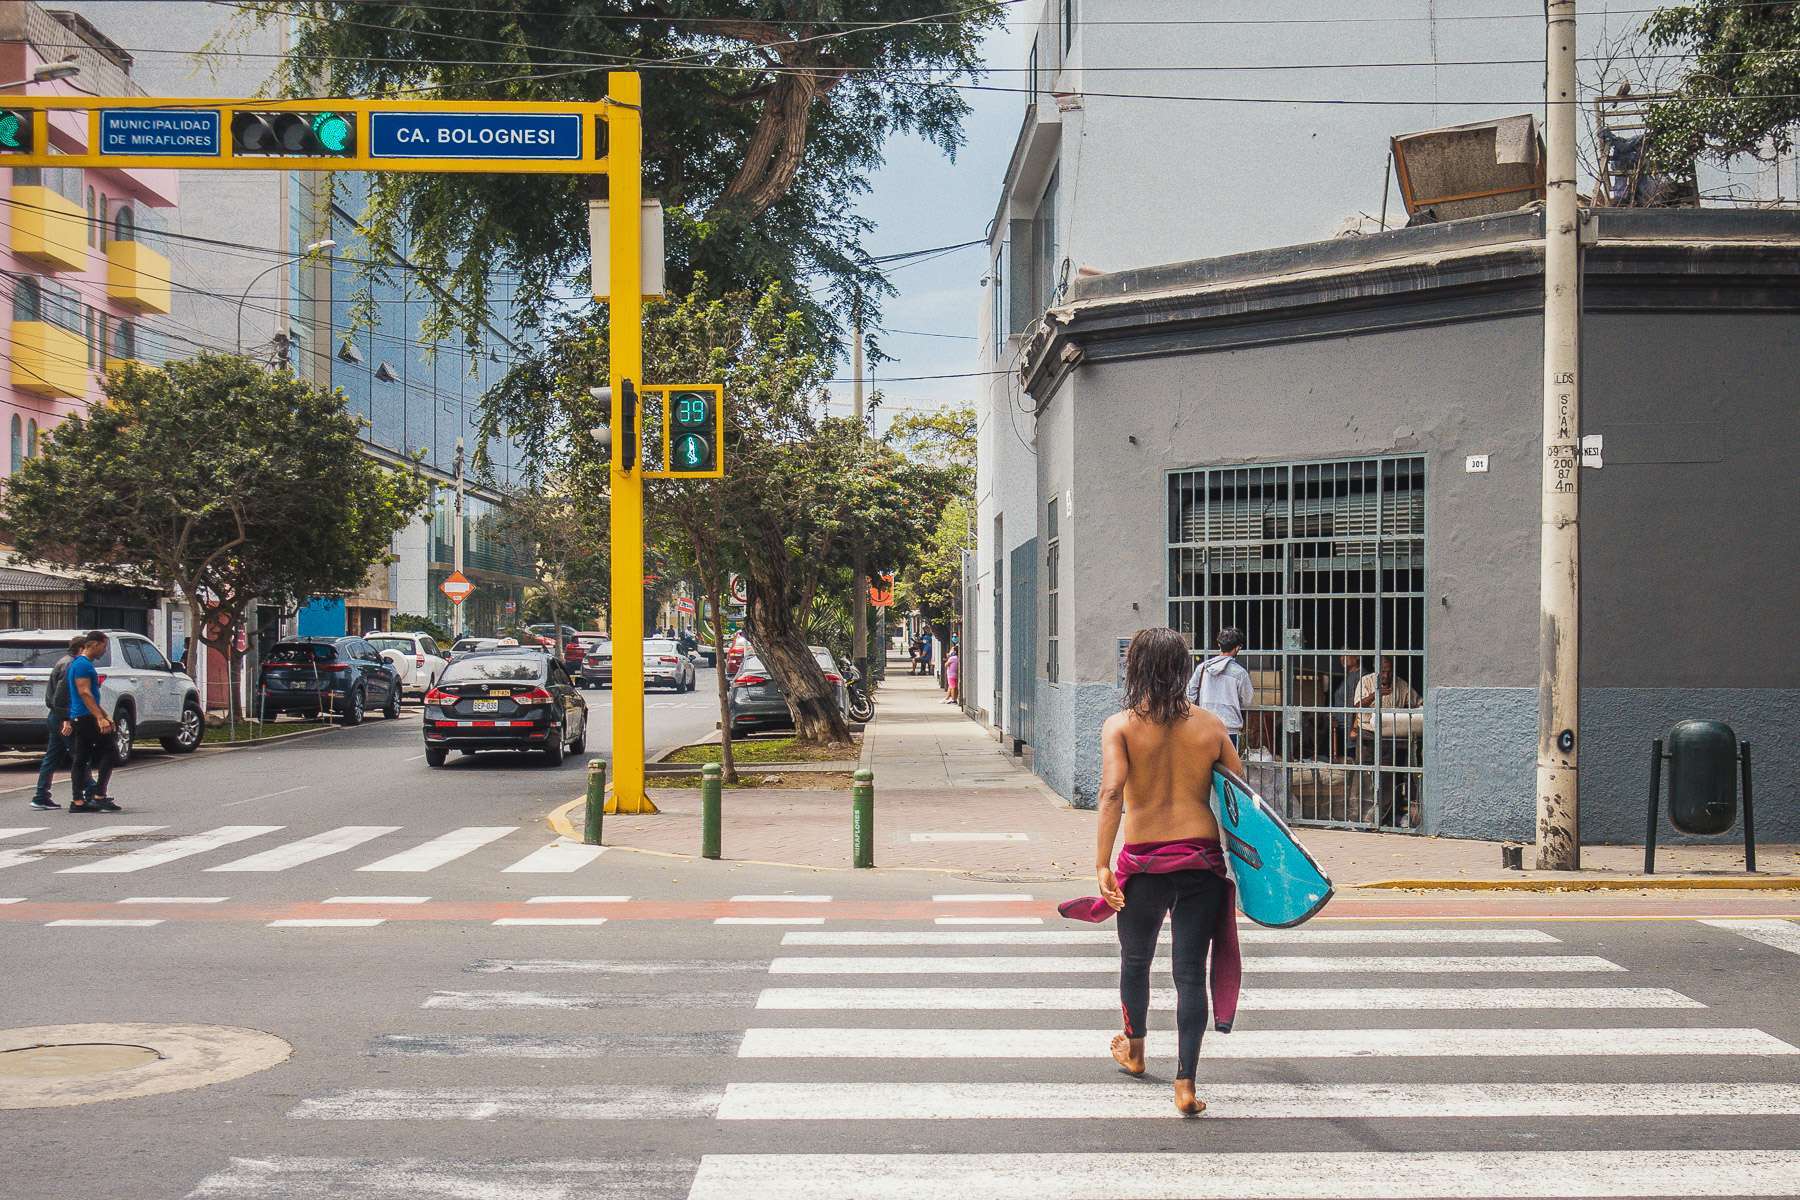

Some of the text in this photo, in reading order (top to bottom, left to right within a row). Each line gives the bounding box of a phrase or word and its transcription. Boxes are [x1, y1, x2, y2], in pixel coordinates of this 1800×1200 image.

[109, 118, 212, 131] MUNICIPALIDAD
[109, 133, 212, 147] DE MIRAFLORES
[396, 127, 556, 145] CA. BOLOGNESI
[1556, 374, 1574, 384] LDS
[680, 400, 703, 422] 39
[1553, 458, 1573, 469] 200
